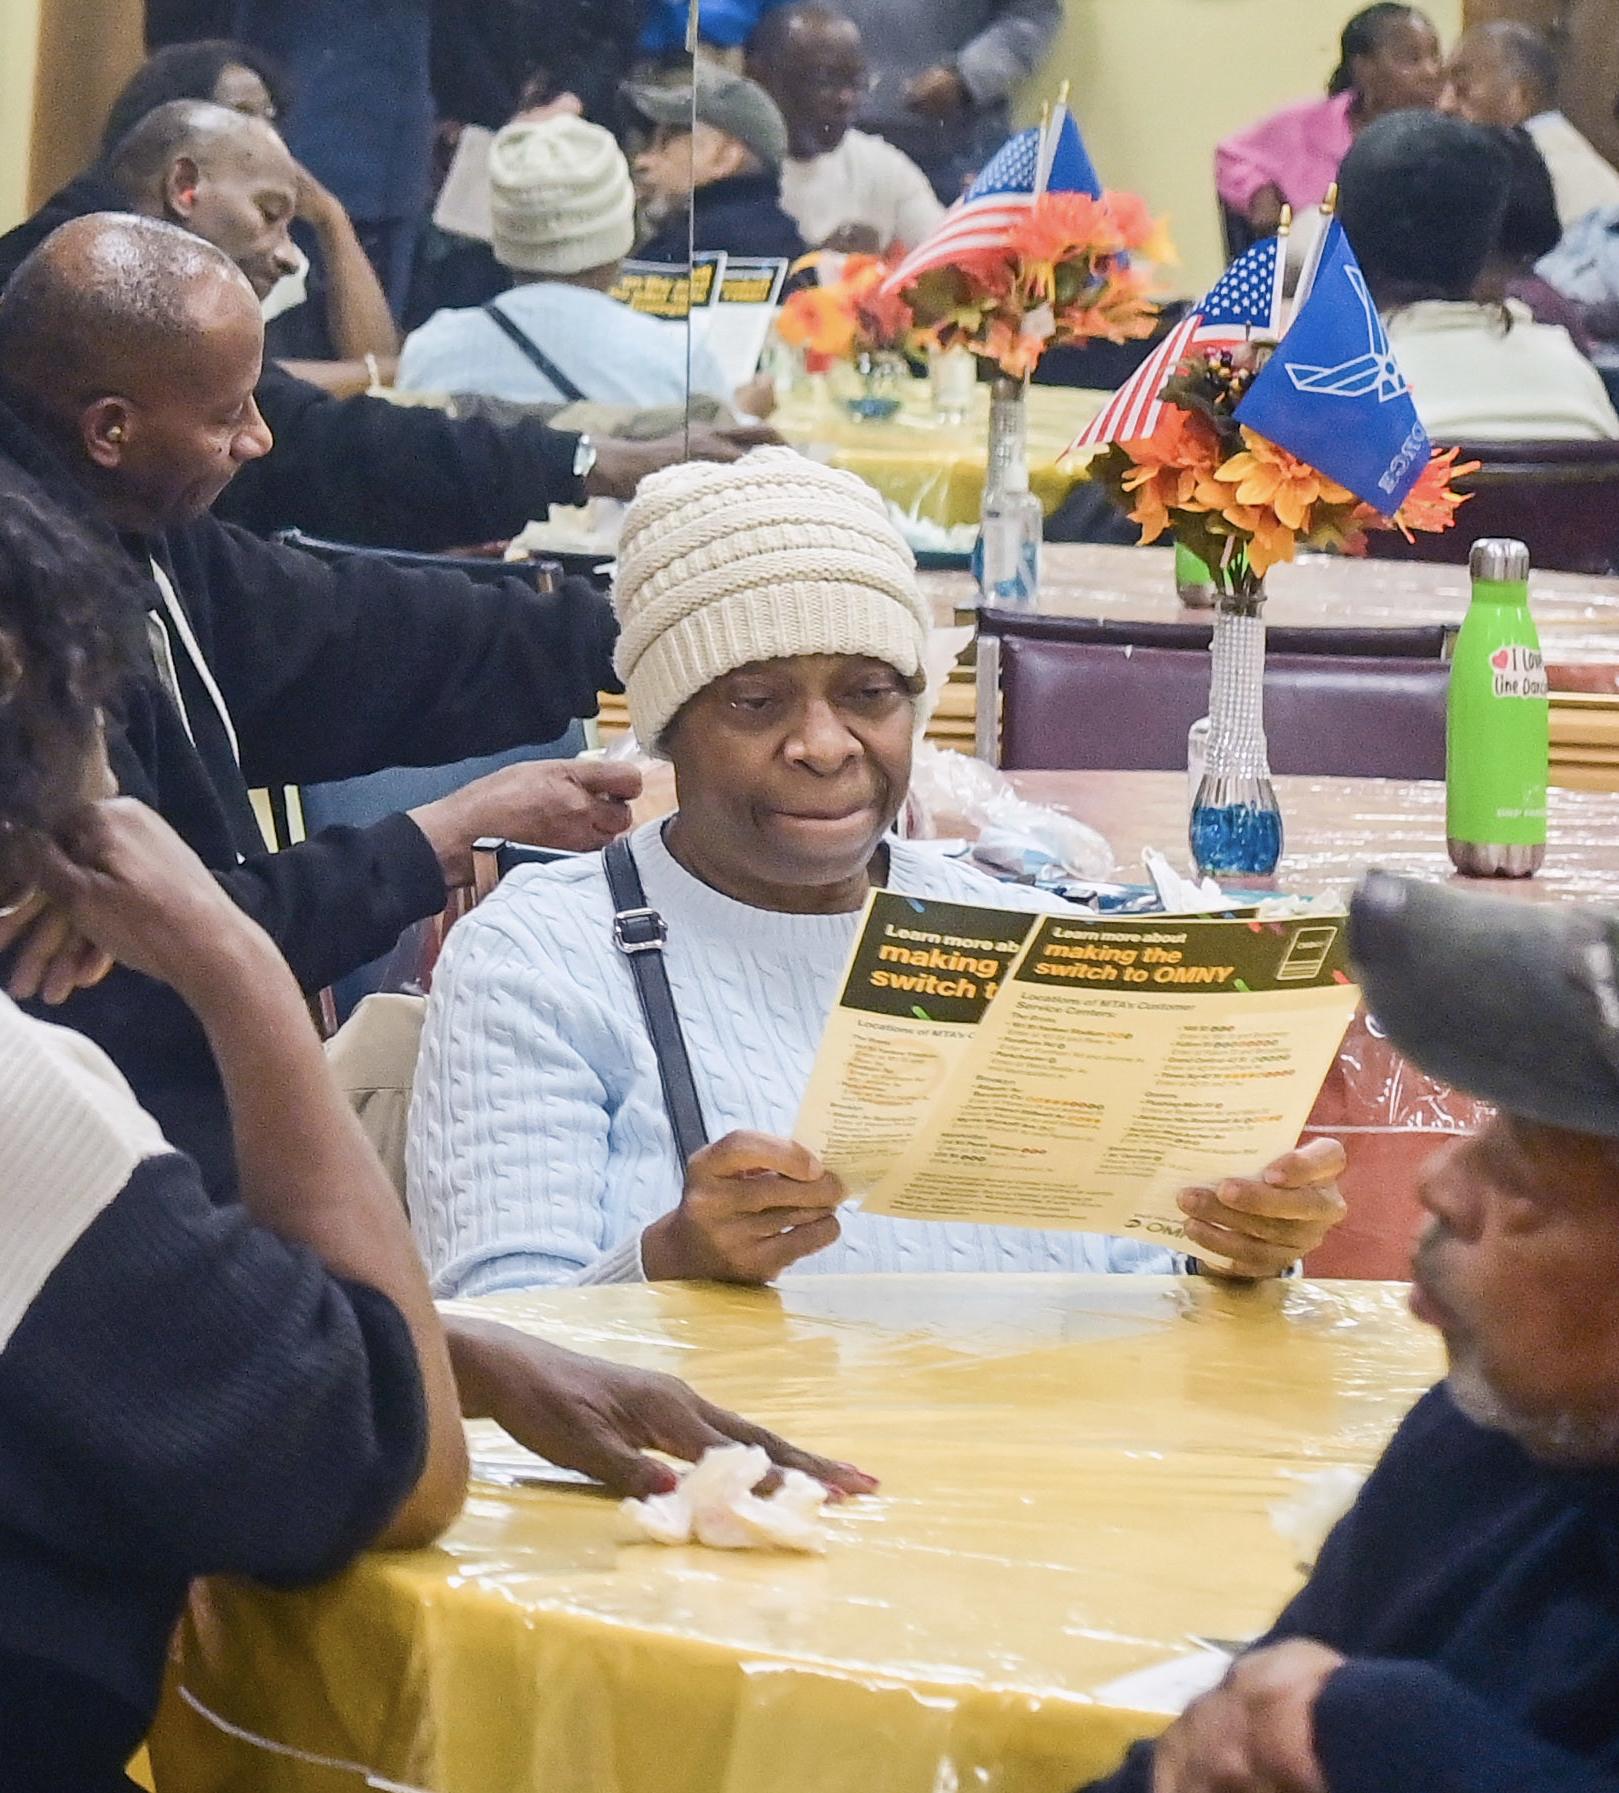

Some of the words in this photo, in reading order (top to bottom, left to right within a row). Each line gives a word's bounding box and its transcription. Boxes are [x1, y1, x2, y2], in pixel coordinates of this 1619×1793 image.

[884, 923, 942, 944] Learn
[943, 935, 994, 951] more
[1052, 926, 1100, 941] Learn
[1100, 932, 1142, 942] more
[1142, 932, 1187, 944] about
[878, 944, 999, 979] making
[1043, 943, 1139, 966] making
[1142, 946, 1183, 964] the
[869, 970, 977, 999] switch
[985, 981, 999, 1000] t
[1033, 962, 1118, 981] switch
[1123, 966, 1149, 983] to
[1153, 966, 1235, 984] OMNY
